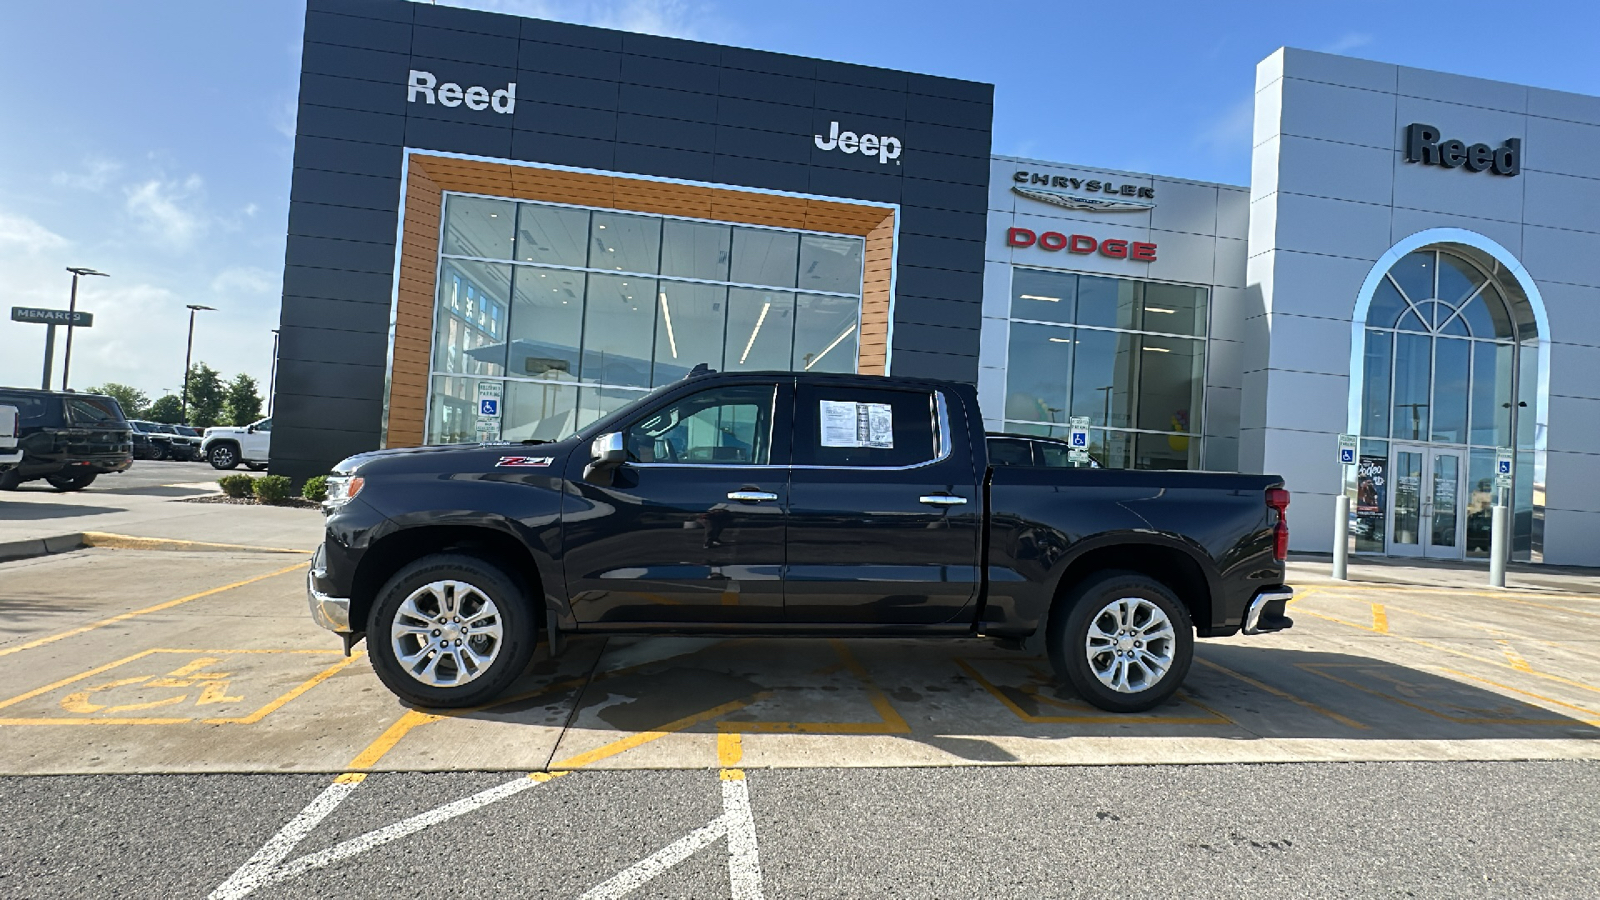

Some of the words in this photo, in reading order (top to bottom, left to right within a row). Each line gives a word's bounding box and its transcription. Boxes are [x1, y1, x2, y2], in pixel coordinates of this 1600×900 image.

[407, 69, 517, 115] Reed
[814, 121, 902, 165] Jeep
[1405, 122, 1521, 177] Reed
[1013, 171, 1156, 199] CHRYSLER
[1007, 226, 1158, 262] DODGE
[494, 456, 556, 468] Z71
